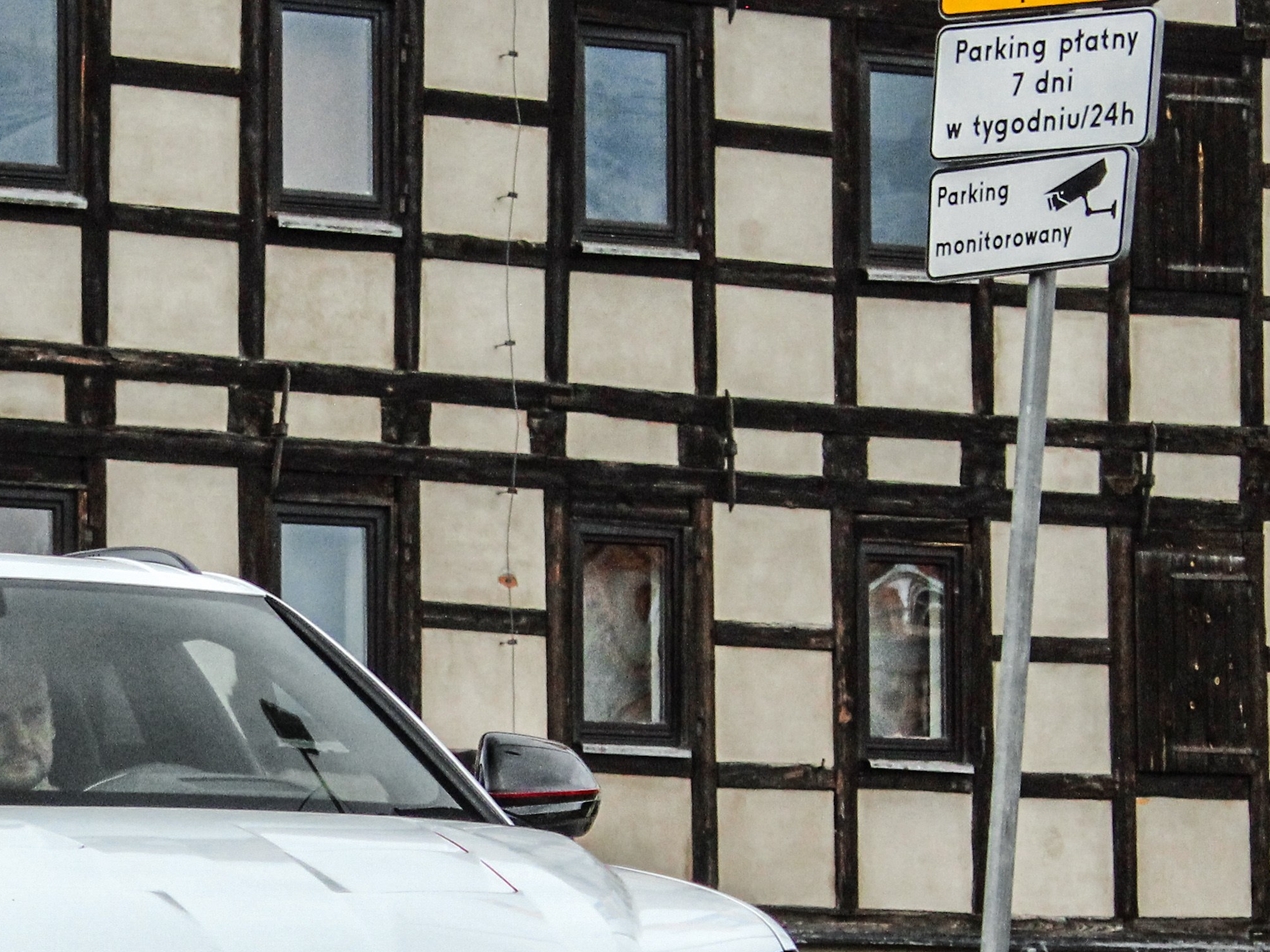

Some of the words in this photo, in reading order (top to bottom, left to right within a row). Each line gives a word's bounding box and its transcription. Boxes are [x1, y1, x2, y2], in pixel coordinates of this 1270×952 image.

[955, 36, 1046, 64] Parking
[1059, 29, 1139, 61] płatny
[1012, 73, 1025, 97] 7
[1035, 68, 1073, 94] dni
[946, 122, 962, 140] w
[973, 101, 1134, 144] tygodniu/24h
[937, 183, 1009, 208] Parking
[935, 226, 1073, 257] monitorowany
